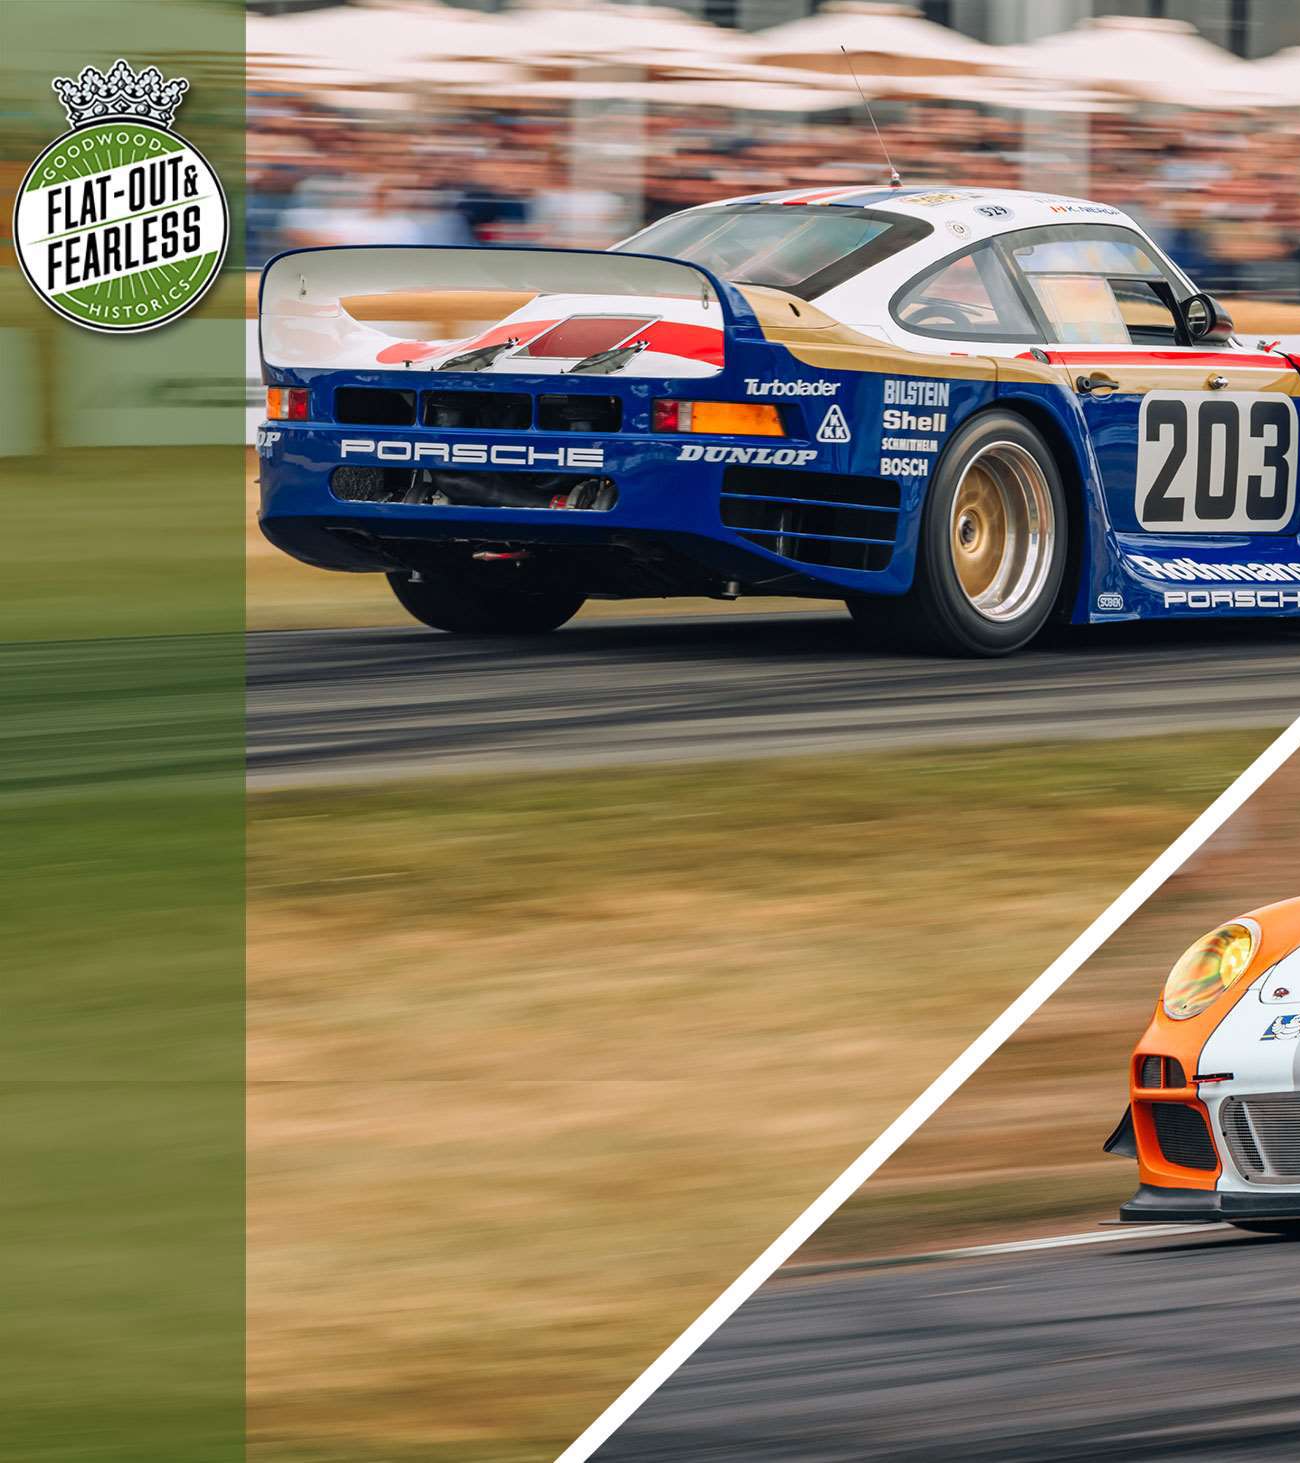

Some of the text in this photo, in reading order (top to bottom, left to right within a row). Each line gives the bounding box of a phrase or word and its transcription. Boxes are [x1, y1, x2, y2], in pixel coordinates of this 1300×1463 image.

[743, 378, 841, 396] Turbolader
[883, 379, 950, 407] BILSTEIN
[882, 409, 947, 432] Shell
[340, 439, 604, 468] PORSCHE
[676, 444, 818, 466] DUNLOP
[1142, 400, 1292, 522] 203
[879, 457, 928, 476] BOSCH
